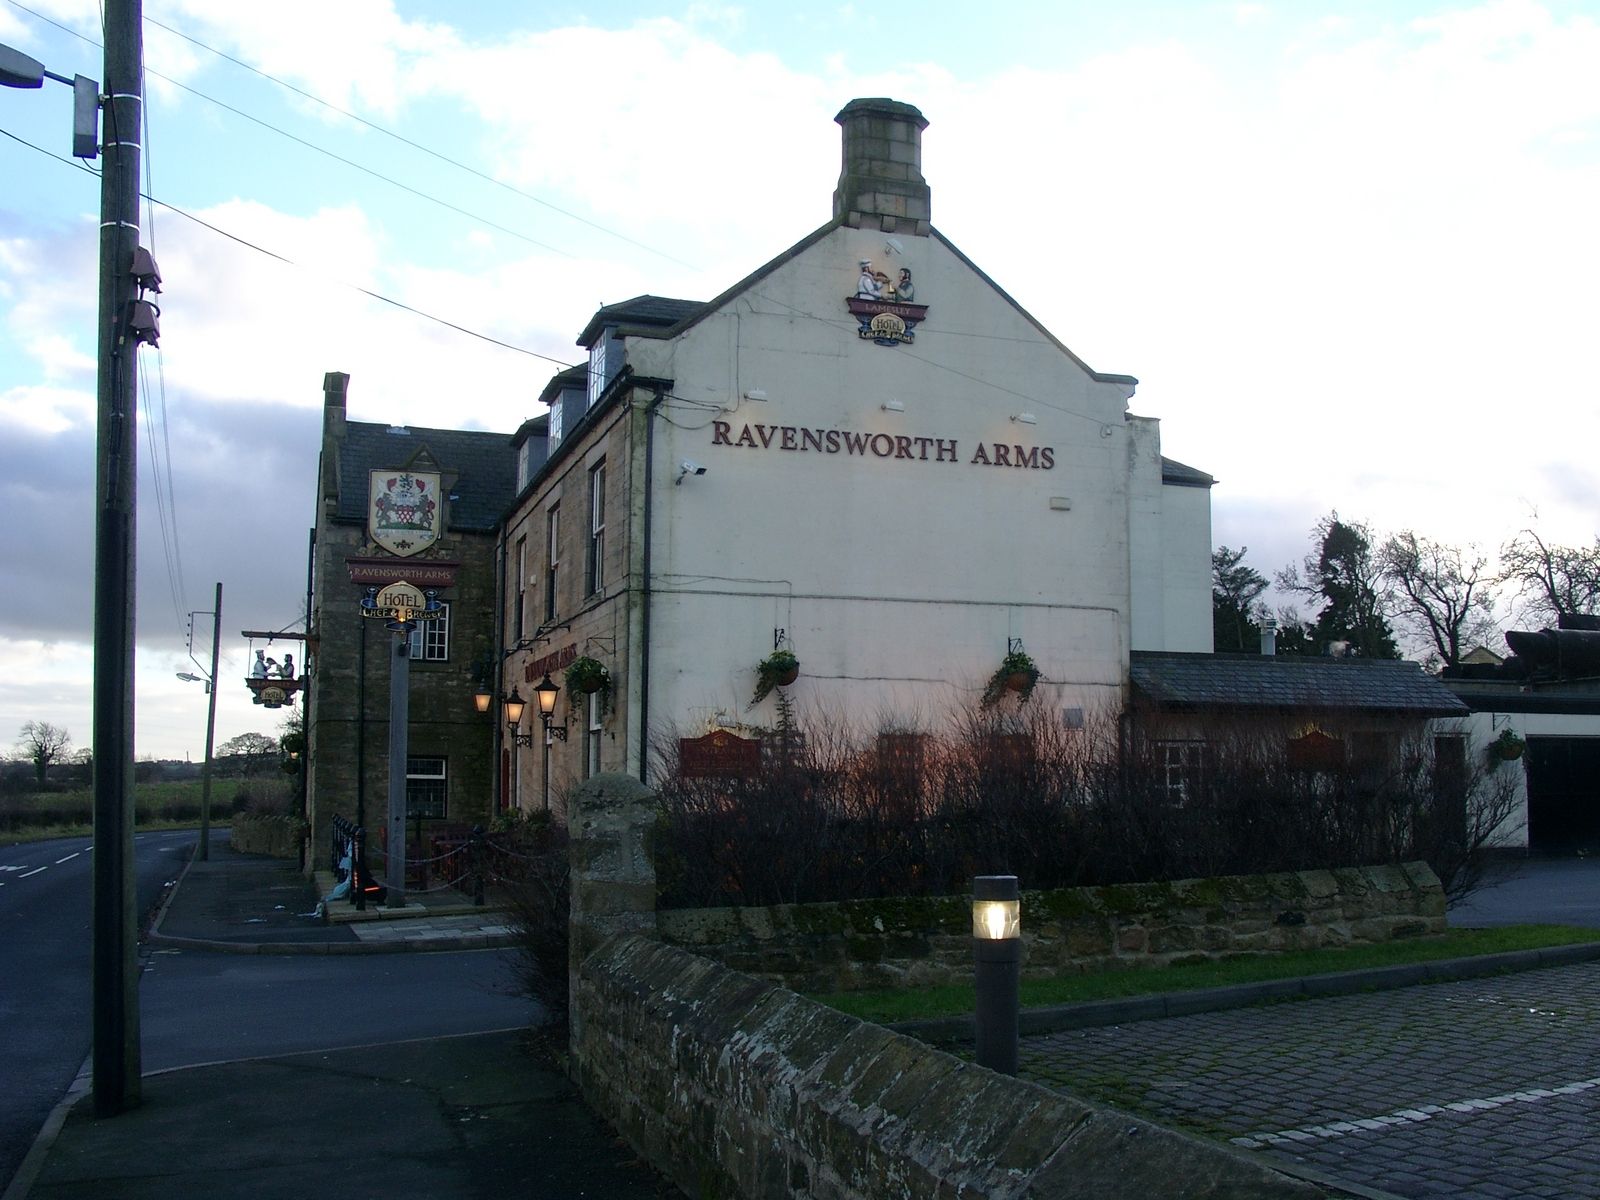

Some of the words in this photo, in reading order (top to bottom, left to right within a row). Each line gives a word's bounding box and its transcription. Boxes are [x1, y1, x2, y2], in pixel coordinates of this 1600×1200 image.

[876, 319, 901, 331] HOTEL
[712, 420, 957, 463] RAVENSWORTH
[970, 442, 1055, 470] ARMS
[354, 567, 422, 578] RAVENSWORTH
[424, 571, 450, 579] ARMS
[383, 593, 420, 608] HOTEL
